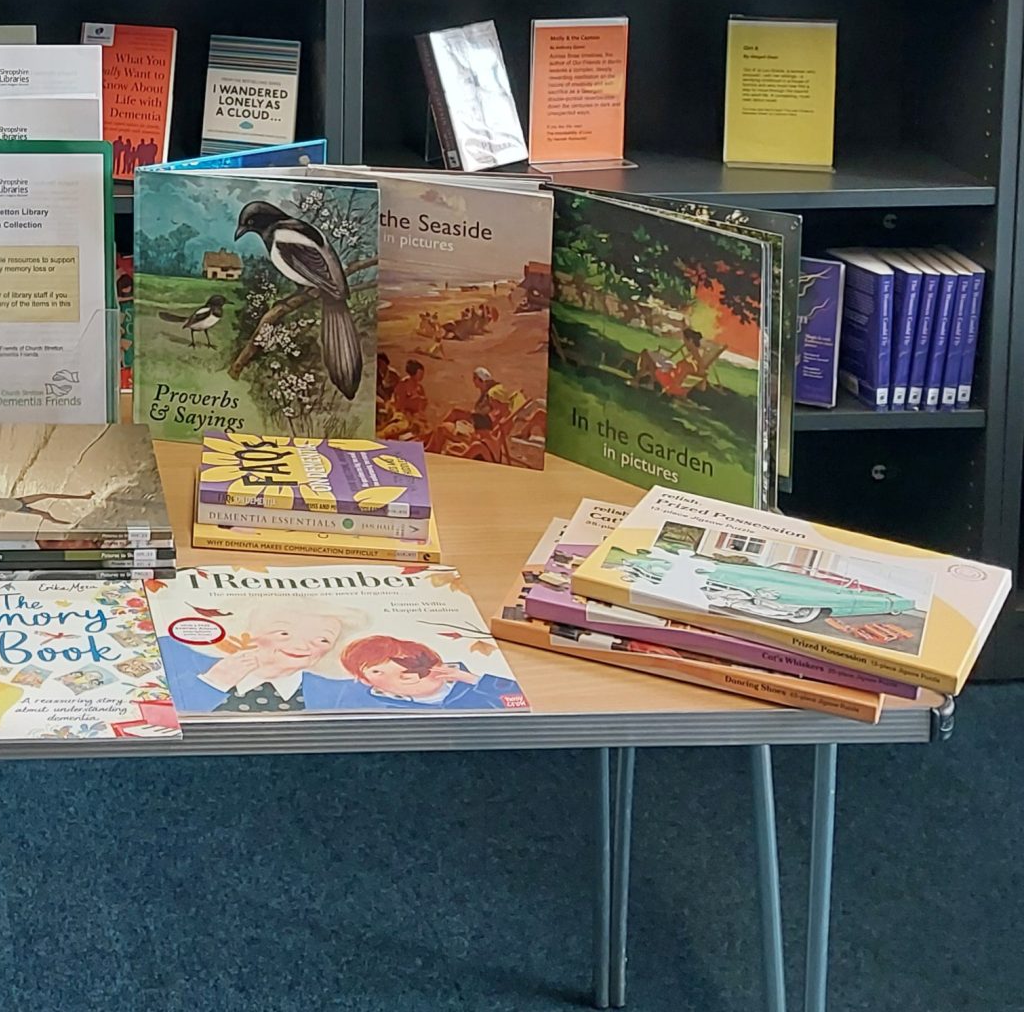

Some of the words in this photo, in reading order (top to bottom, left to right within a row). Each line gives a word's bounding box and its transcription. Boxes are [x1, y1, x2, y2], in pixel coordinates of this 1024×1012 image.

[116, 53, 143, 64] What
[146, 56, 166, 66] You
[124, 69, 151, 79] Want
[154, 71, 165, 79] to
[131, 82, 163, 93] About
[213, 84, 216, 93] I
[219, 84, 288, 99] WANDERED
[115, 94, 136, 106] Life
[140, 96, 162, 107] with
[219, 96, 265, 108] LONELY
[265, 101, 280, 109] AS
[110, 108, 161, 122] Dementia
[216, 107, 224, 116] A
[22, 208, 48, 217] Library
[3, 221, 42, 229] Collection
[379, 209, 410, 229] the
[419, 214, 493, 241] Seaside
[383, 232, 396, 244] in
[399, 236, 454, 253] pictures
[153, 383, 240, 410] Proverbs
[149, 402, 169, 420] &
[173, 406, 245, 432] Sayings
[572, 407, 588, 432] In
[597, 419, 628, 445] the
[637, 432, 713, 477] Garden
[603, 443, 616, 460] in
[620, 452, 679, 483] pictures
[209, 512, 267, 524] DEMENTIA
[271, 514, 337, 528] ESSENTIALS
[655, 499, 711, 516] Prized
[713, 512, 807, 539] Possession
[225, 540, 258, 549] DEMENTIA
[260, 542, 282, 551] MAKES
[284, 543, 344, 554] COMMUNICATION
[346, 548, 378, 557] DIFFICULT
[220, 571, 423, 590] Remember
